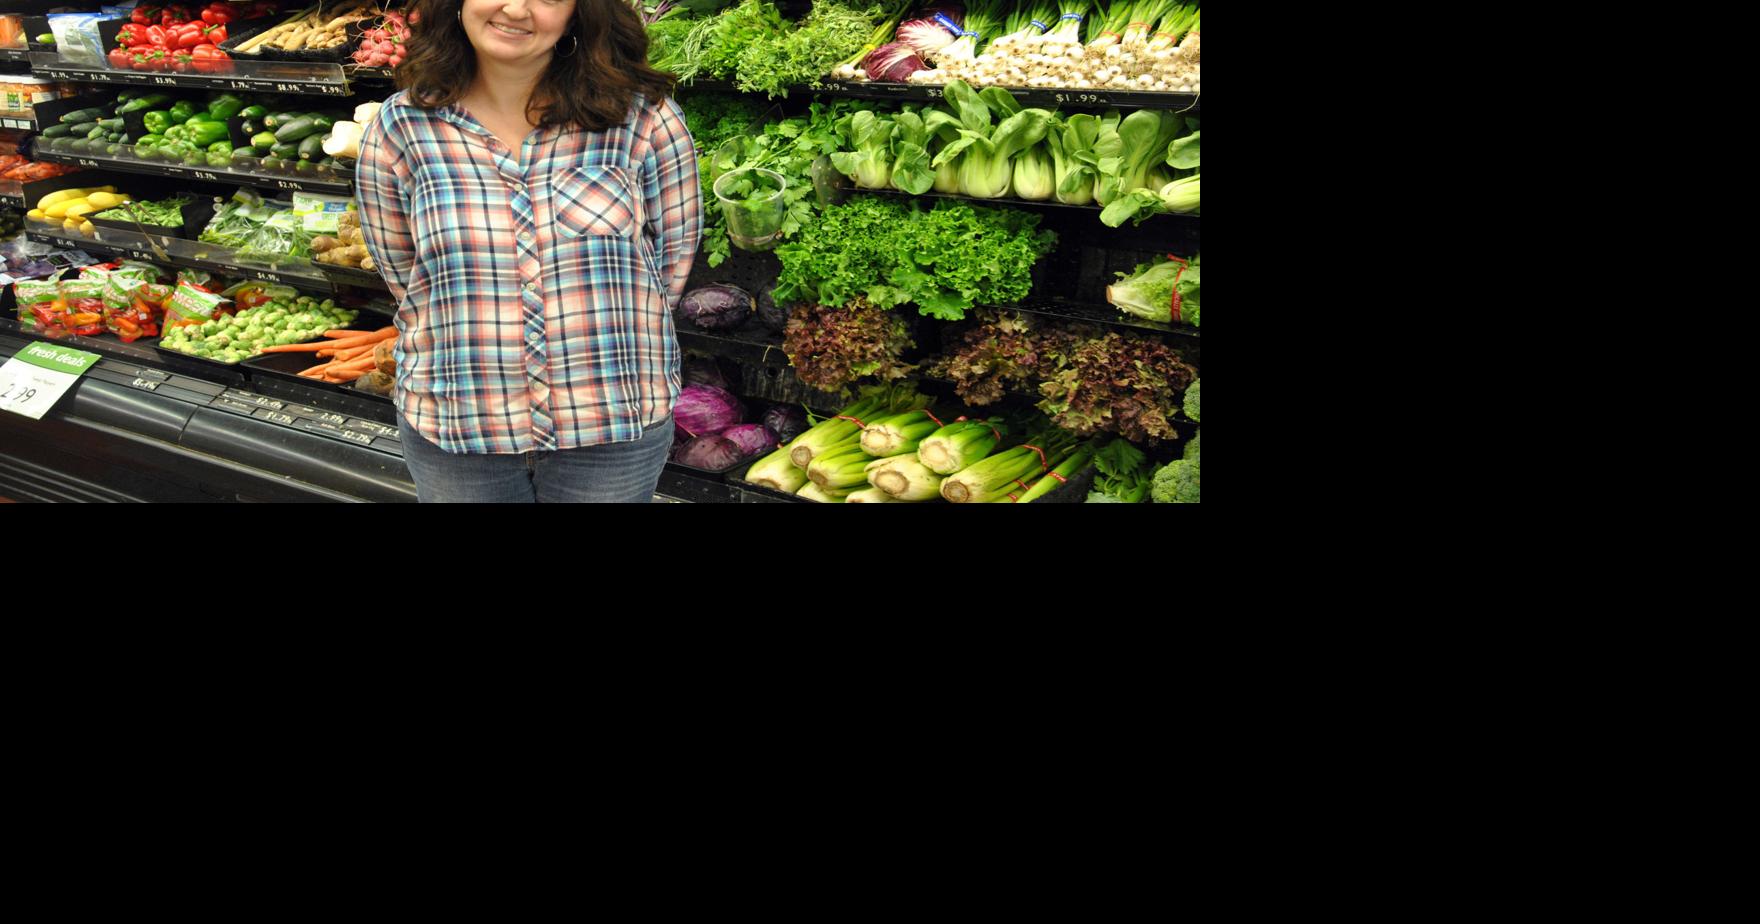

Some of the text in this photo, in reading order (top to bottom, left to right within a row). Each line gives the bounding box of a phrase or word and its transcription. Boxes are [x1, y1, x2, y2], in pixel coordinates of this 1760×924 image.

[1055, 93, 1097, 103] $1.99
[27, 345, 86, 367] fresh deals
